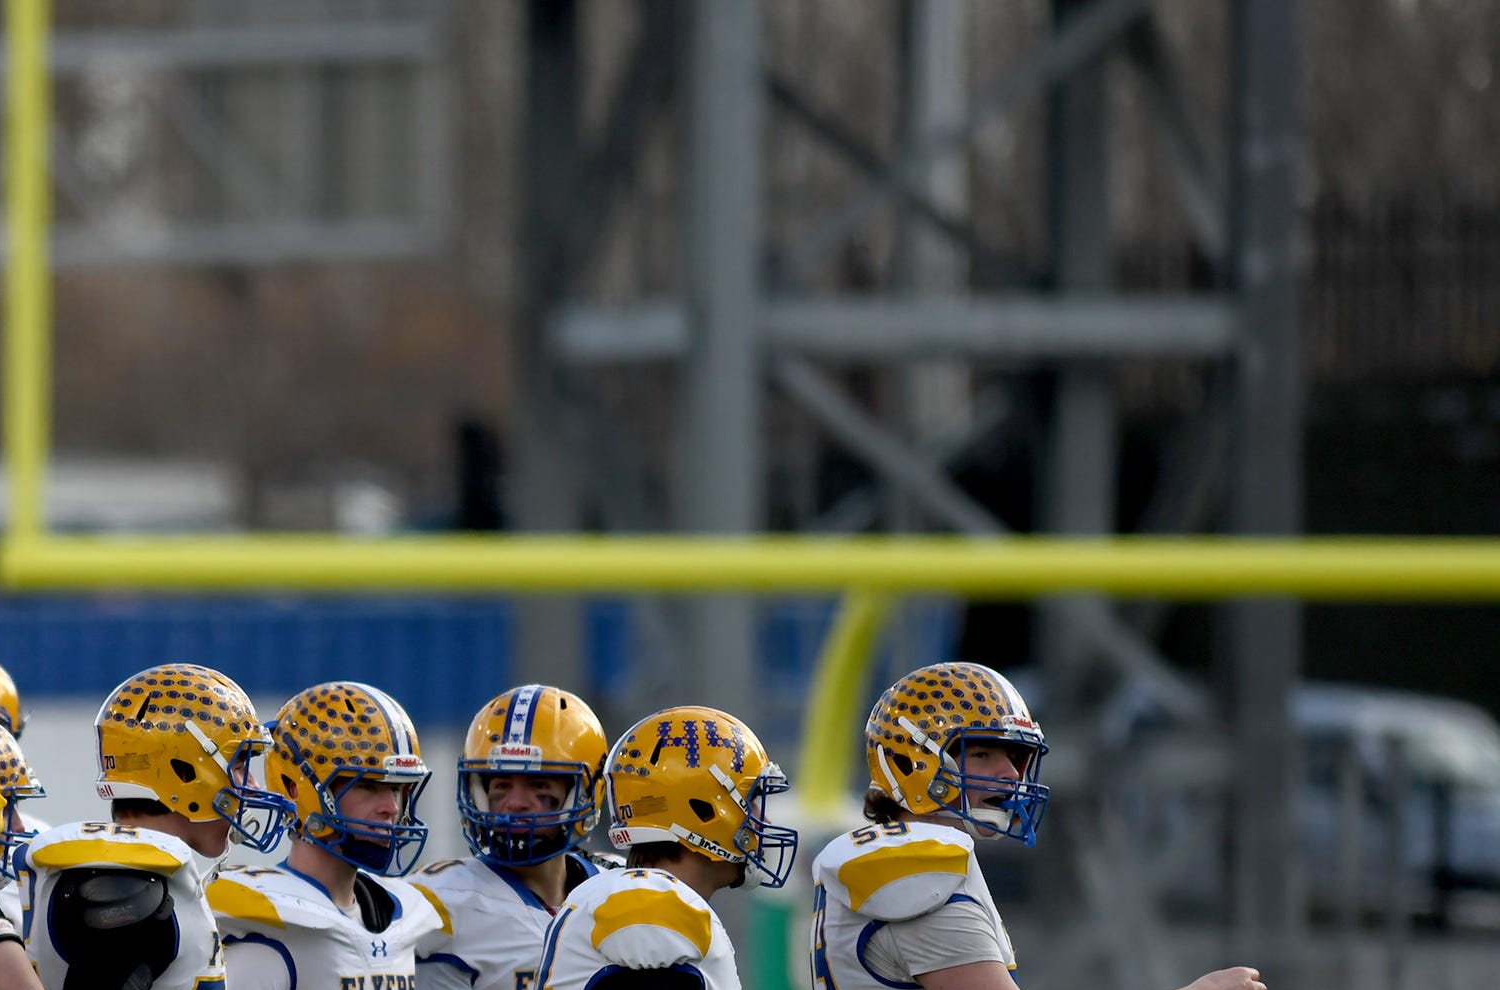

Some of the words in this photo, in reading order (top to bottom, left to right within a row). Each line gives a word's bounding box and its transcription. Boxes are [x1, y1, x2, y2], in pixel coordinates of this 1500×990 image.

[501, 746, 531, 757] Riddell
[103, 755, 116, 770] 70
[618, 804, 633, 821] 70
